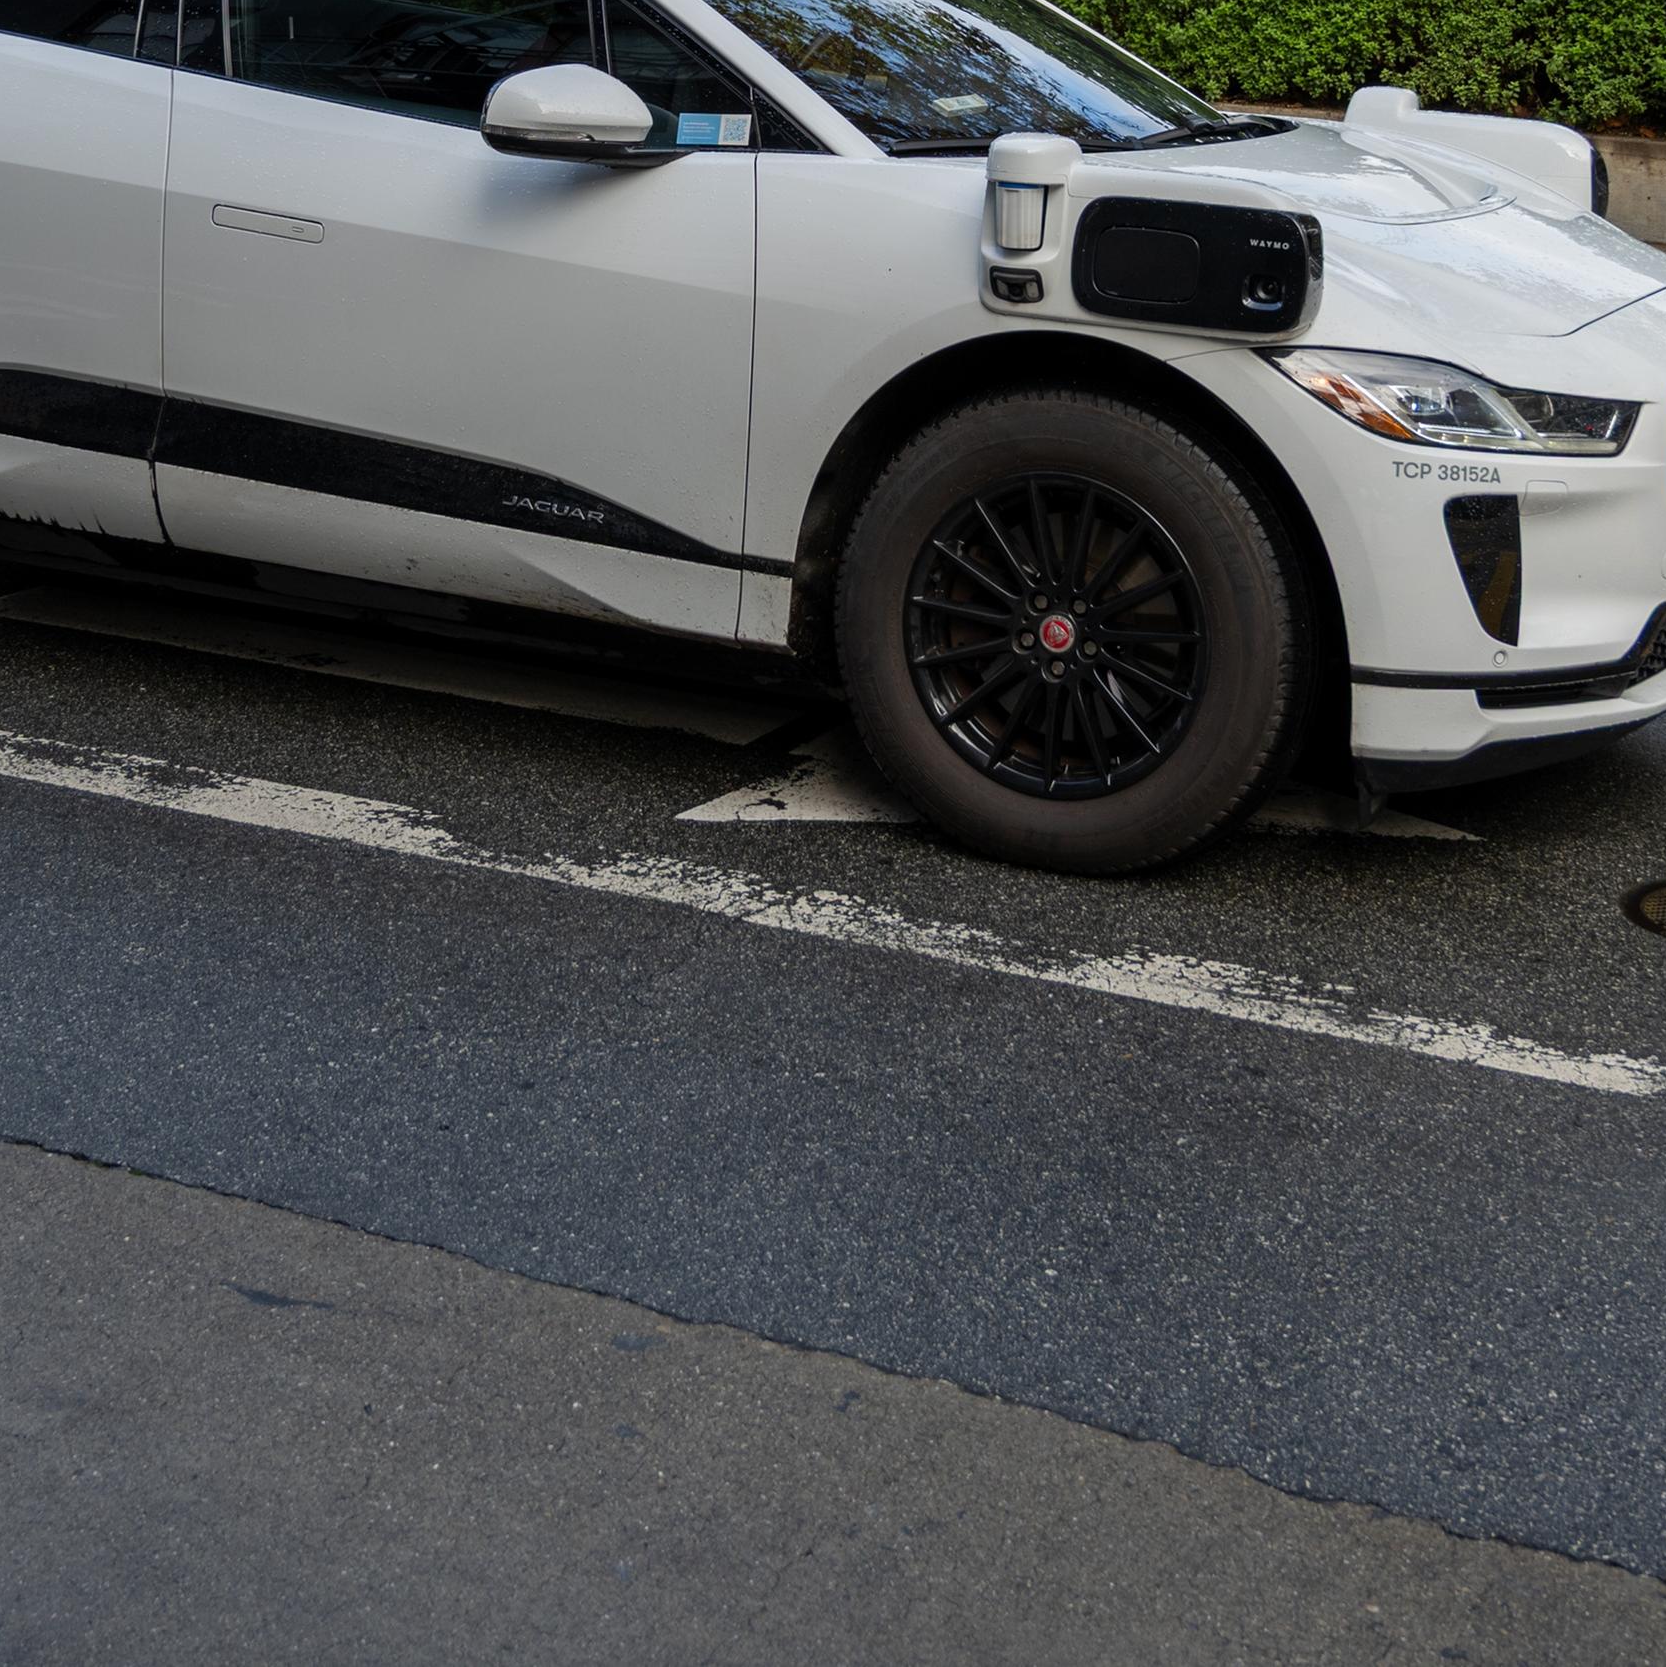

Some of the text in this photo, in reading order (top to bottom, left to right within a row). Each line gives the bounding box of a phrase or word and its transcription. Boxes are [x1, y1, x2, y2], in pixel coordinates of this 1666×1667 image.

[1249, 238, 1290, 250] WAYMO
[1392, 461, 1501, 484] TCP 38152A
[502, 495, 605, 525] JAGUAR
